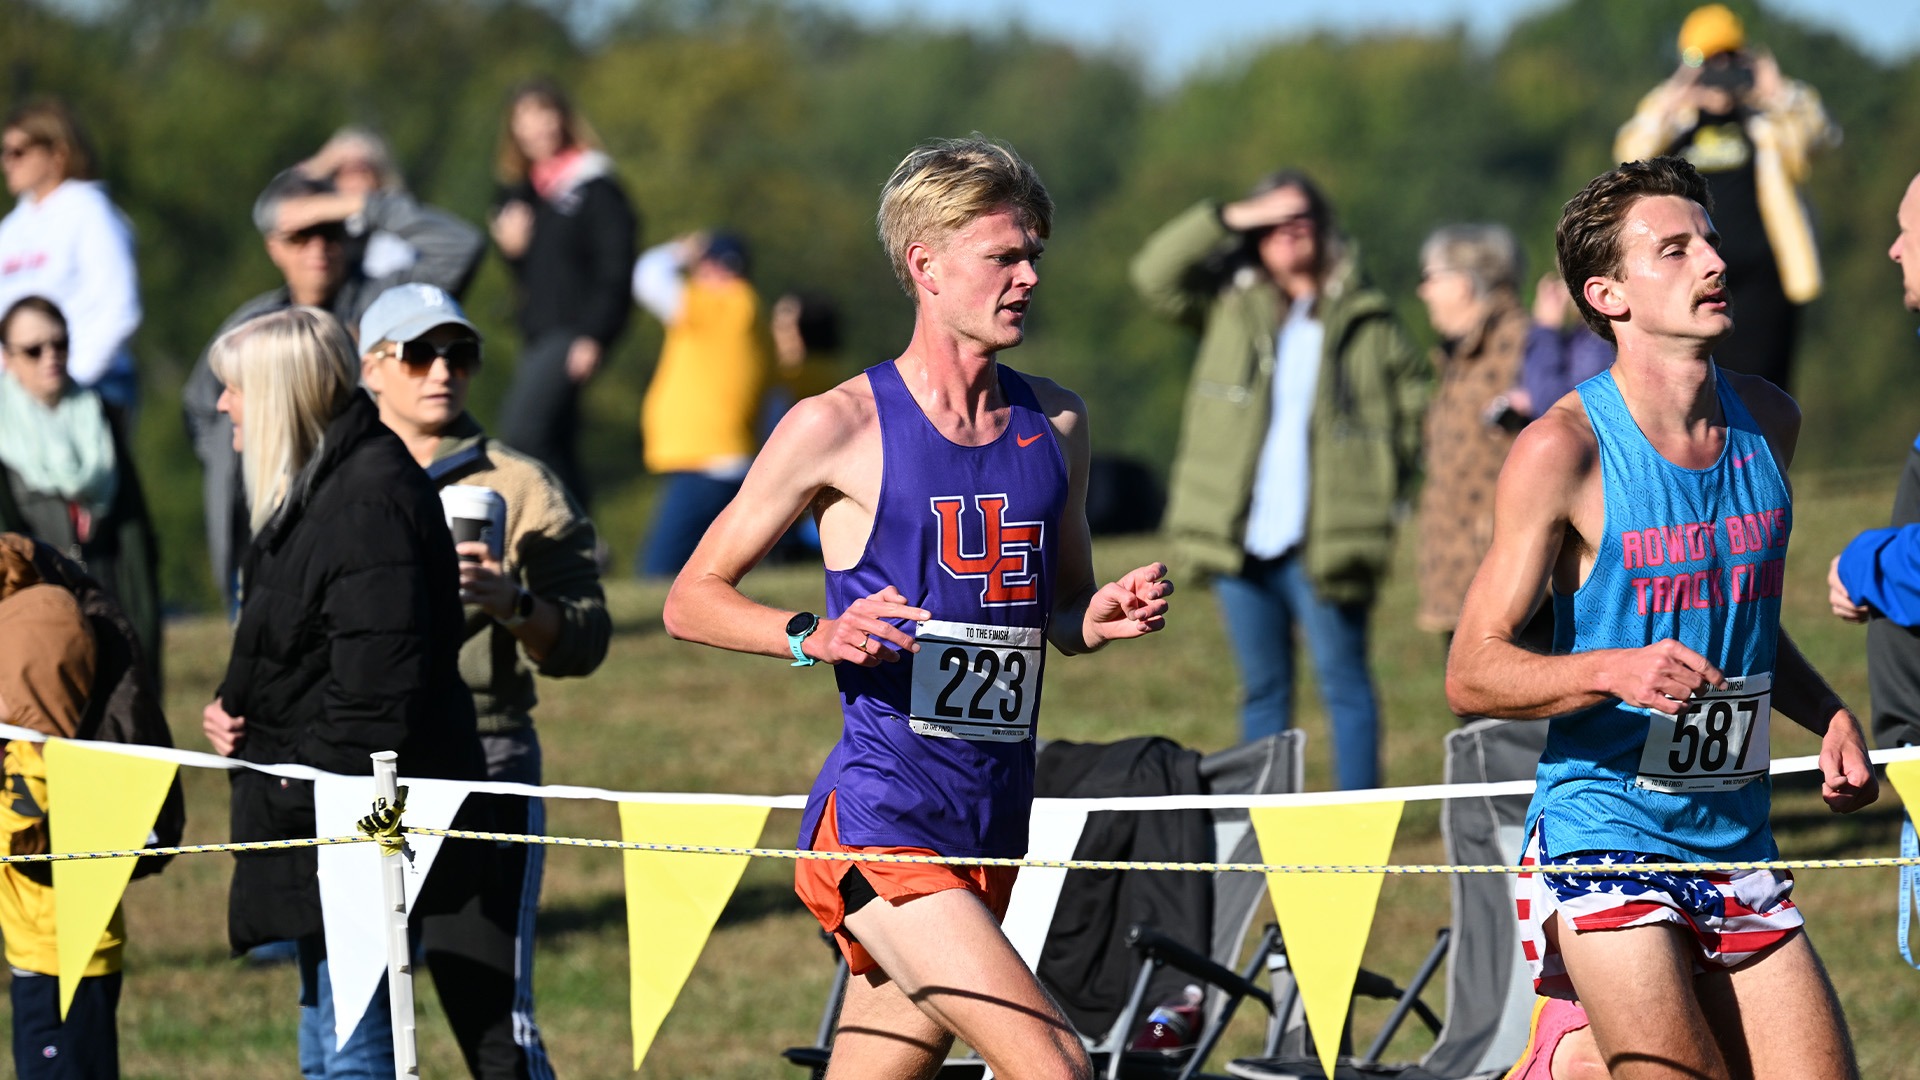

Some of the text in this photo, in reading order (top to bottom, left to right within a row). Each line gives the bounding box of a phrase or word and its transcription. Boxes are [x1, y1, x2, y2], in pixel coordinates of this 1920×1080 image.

[930, 493, 1044, 608] UE
[1622, 508, 1787, 570] ROWDY BOYS
[1631, 558, 1785, 616] TRACK CLUB
[966, 627, 1010, 641] TO THE FINISH
[935, 646, 1026, 722] 223
[1723, 680, 1744, 692] INISH
[1668, 699, 1759, 773] 587
